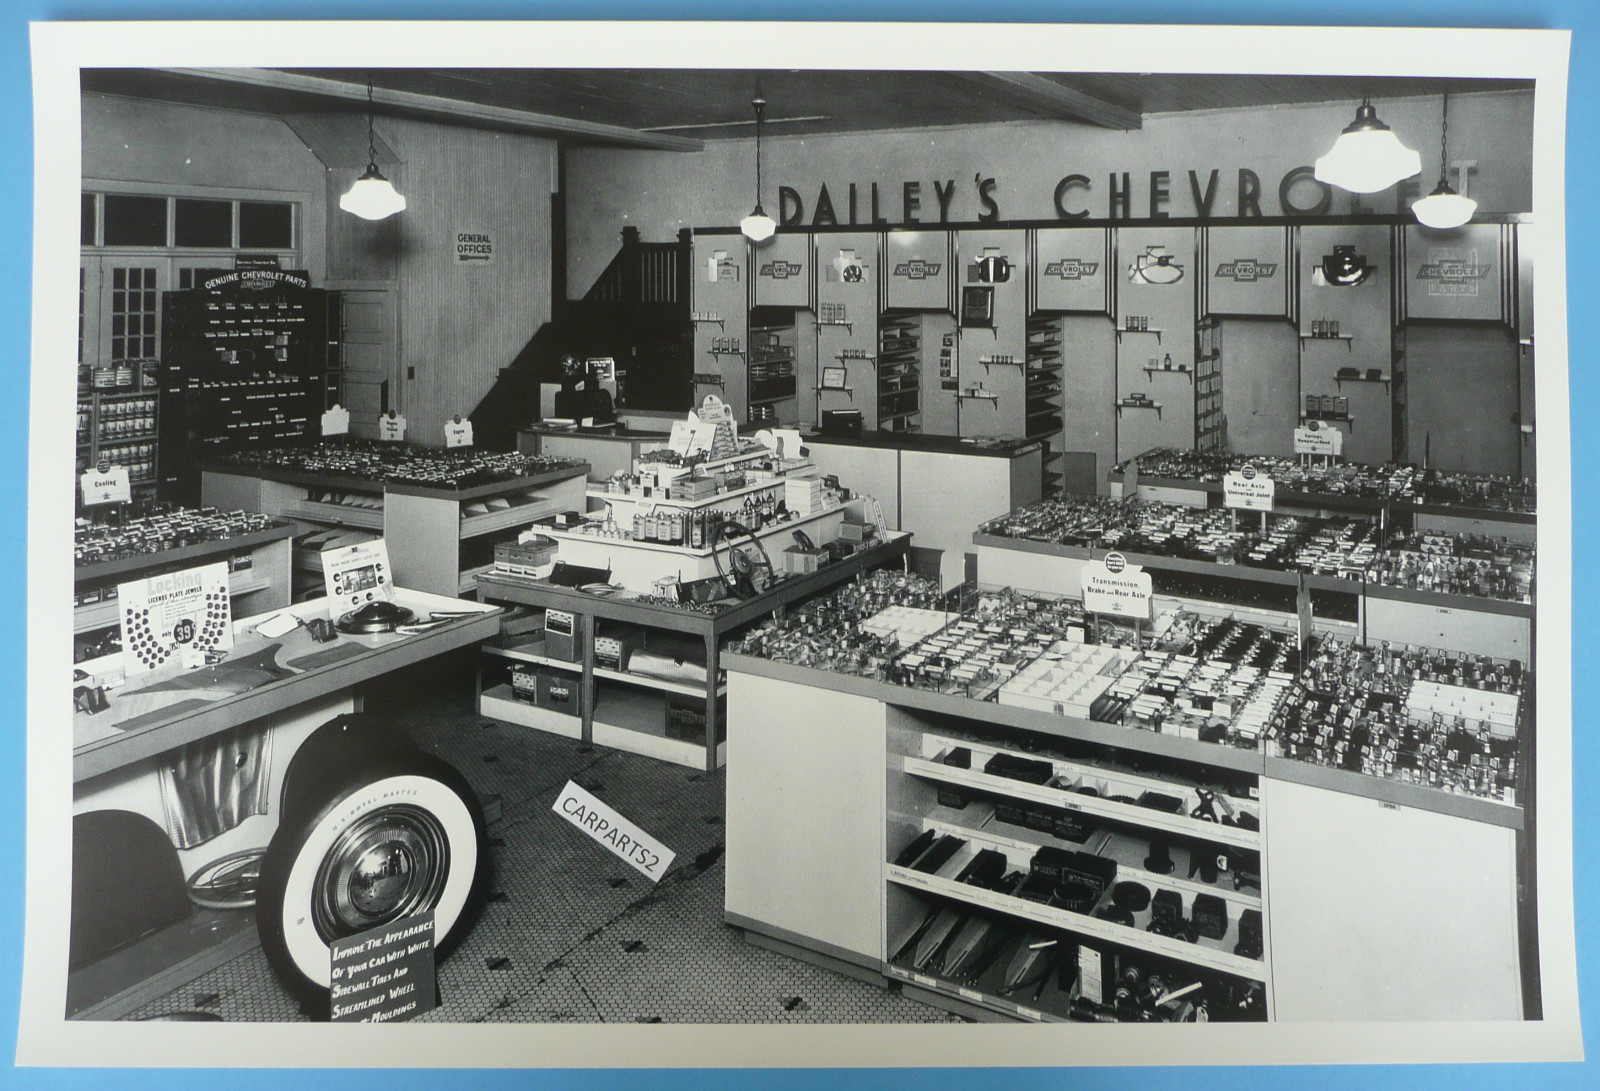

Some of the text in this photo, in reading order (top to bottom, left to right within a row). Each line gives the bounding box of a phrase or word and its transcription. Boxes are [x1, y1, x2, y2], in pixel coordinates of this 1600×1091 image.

[778, 172, 999, 226] DAILEY'S
[457, 233, 491, 243] GENERAL
[457, 244, 492, 254] OFFICES
[762, 266, 799, 274] CHEVROLET
[899, 266, 937, 274] CHEVROLET
[1221, 267, 1272, 275] CHEVROLET
[205, 271, 307, 290] GENUINE CHEVROLET PARTS
[94, 479, 117, 488] Cooling
[1227, 489, 1255, 497] Universal
[146, 572, 202, 597] Locking
[1092, 577, 1140, 589] Transmission,
[147, 593, 168, 605] LICENSE
[169, 589, 184, 600] PLATE
[184, 585, 203, 596] JEWELS
[1087, 586, 1106, 595] Brake
[1114, 589, 1130, 597] Rear
[1131, 591, 1146, 600] Axle
[350, 797, 377, 816] ROYAL
[383, 789, 418, 799] MASTER
[332, 920, 434, 962] IMPROVE THE APPEARANCE
[332, 939, 431, 980] OF YOUR CAR WITH WHITE
[332, 967, 409, 999] SIDEWALL TIRES AND
[331, 982, 416, 1020] STREAMLINED WHEEL
[371, 1000, 417, 1023] MOULDINGS
